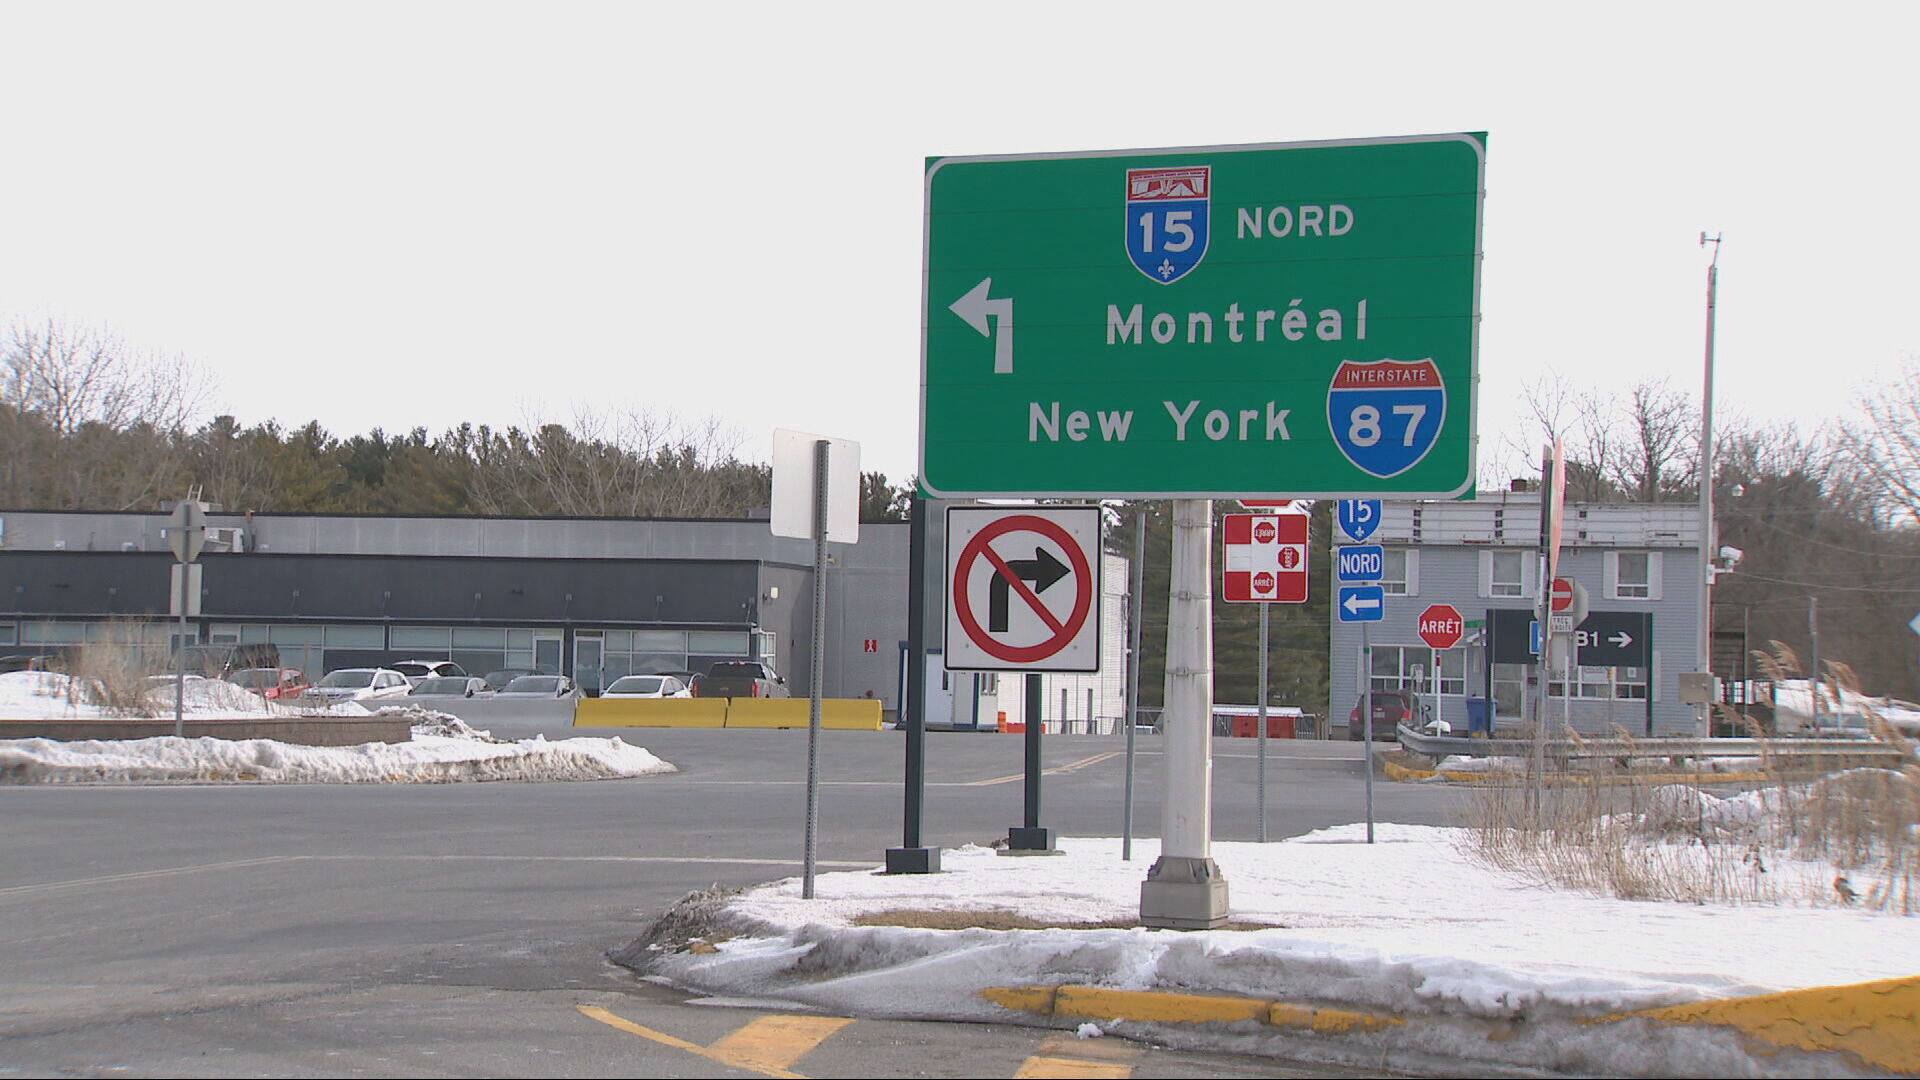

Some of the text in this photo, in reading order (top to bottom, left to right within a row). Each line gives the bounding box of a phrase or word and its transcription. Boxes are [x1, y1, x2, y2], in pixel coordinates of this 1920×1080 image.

[1139, 210, 1195, 253] 15
[1237, 204, 1354, 239] NORD
[1107, 298, 1367, 345] Montréal
[1345, 368, 1427, 383] INTERSTATE
[1028, 400, 1291, 443] New York
[1348, 404, 1428, 447] 87
[1347, 499, 1372, 524] 15
[1341, 554, 1381, 574] NORD
[1420, 619, 1460, 635] ARRÊT
